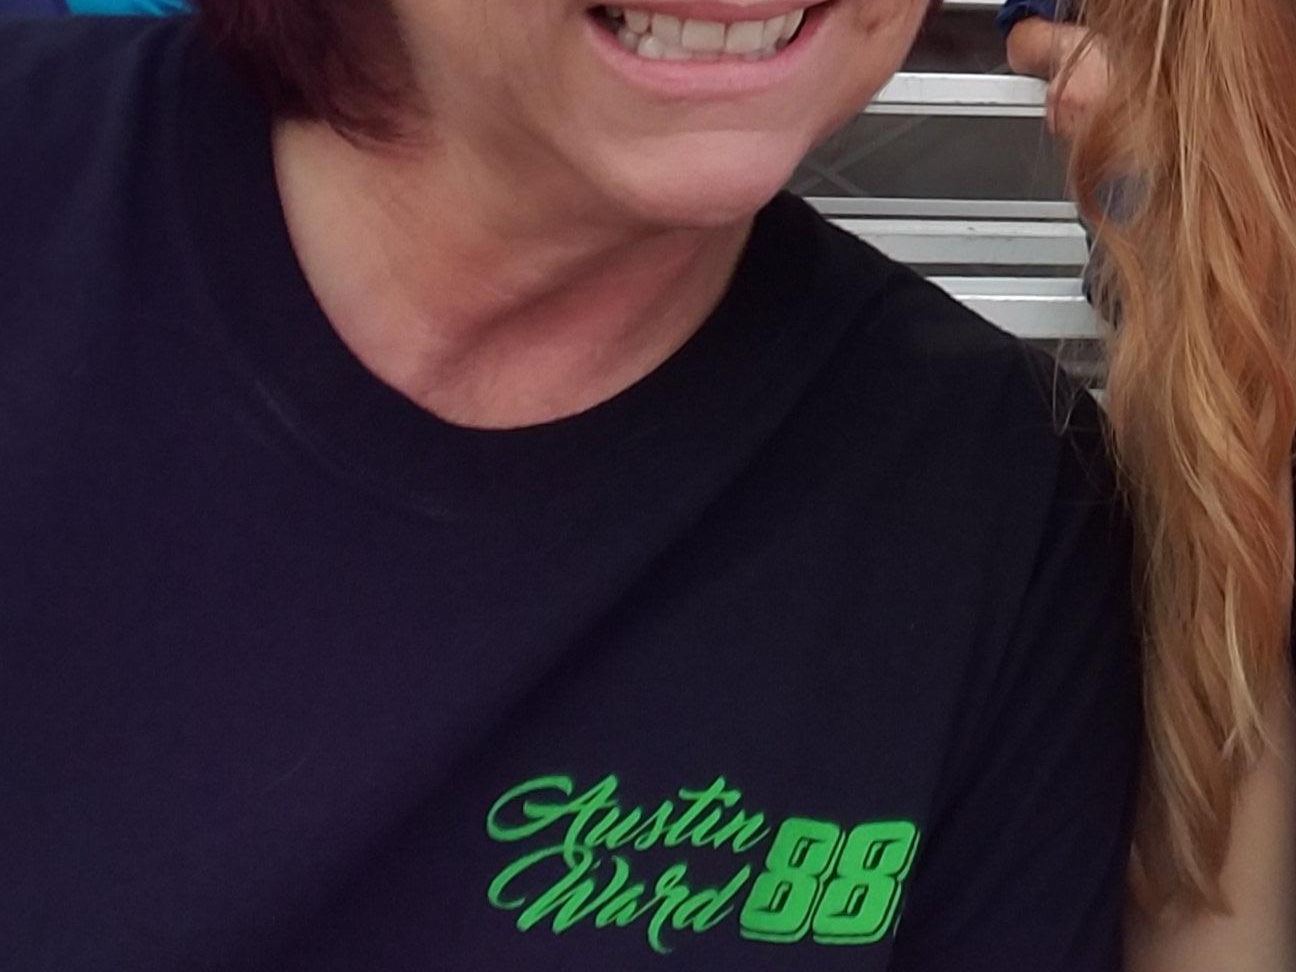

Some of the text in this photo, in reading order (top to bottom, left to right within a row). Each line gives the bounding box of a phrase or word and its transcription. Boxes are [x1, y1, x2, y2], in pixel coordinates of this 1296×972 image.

[487, 774, 771, 868] Austin
[487, 844, 752, 954] Ward
[739, 817, 921, 945] 88
